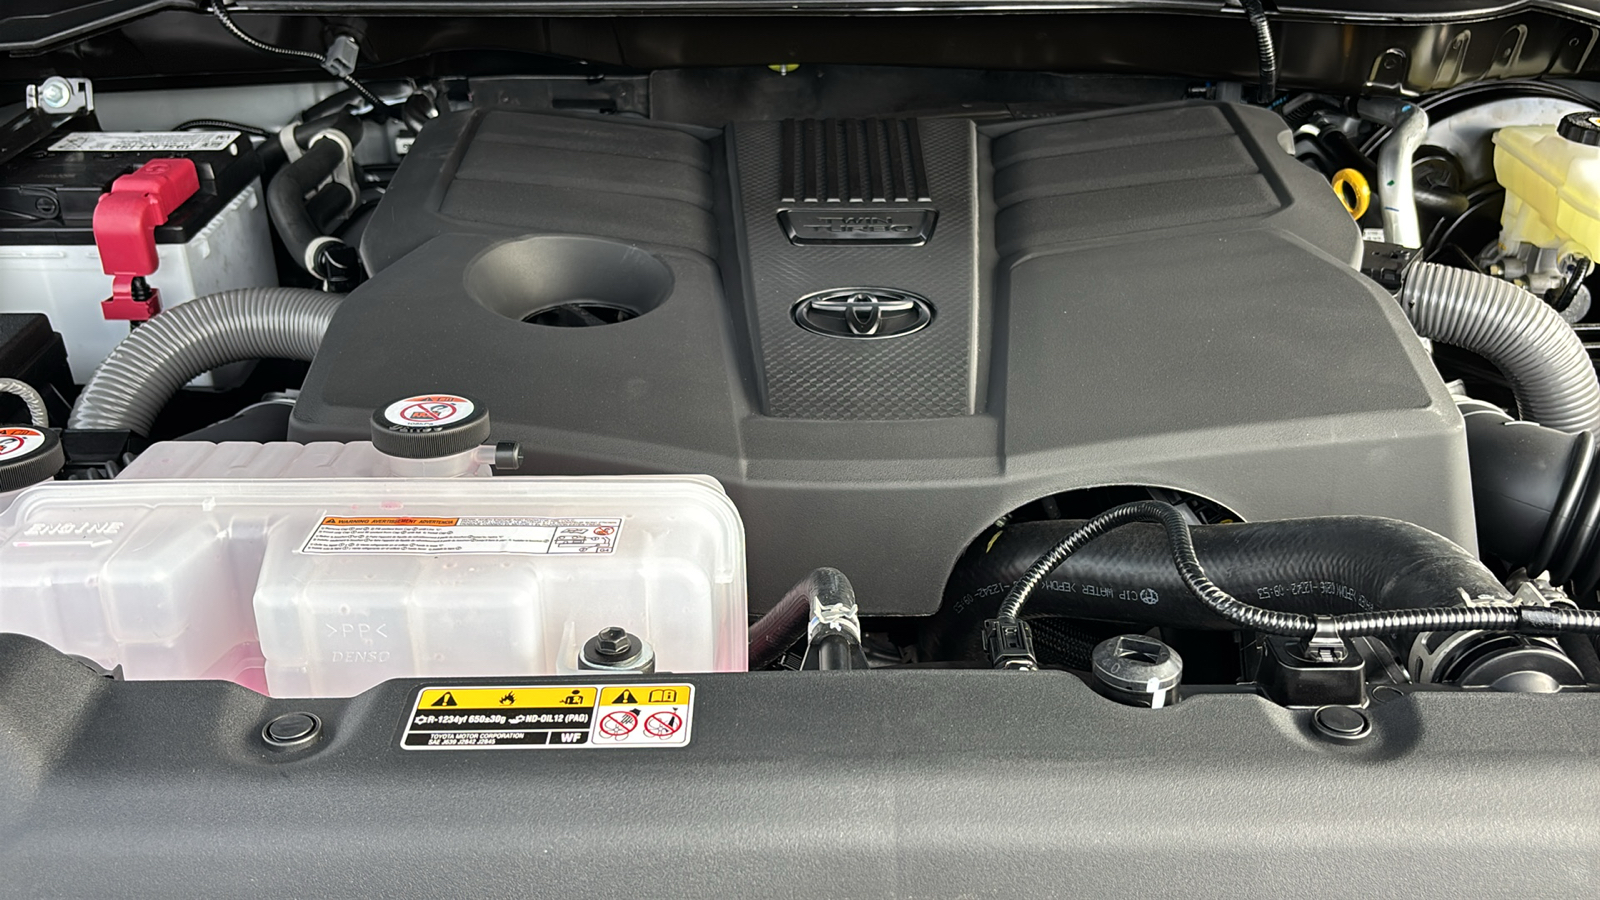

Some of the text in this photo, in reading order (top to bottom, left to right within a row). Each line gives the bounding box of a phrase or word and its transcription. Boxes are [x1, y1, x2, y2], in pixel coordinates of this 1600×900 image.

[818, 216, 892, 224] TWIN
[803, 223, 913, 233] TURBO
[24, 521, 124, 536] ENGINE
[1082, 584, 1115, 599] WATER
[1118, 589, 1139, 601] CIP
[332, 651, 391, 663] DENSO
[560, 732, 582, 743] WF
